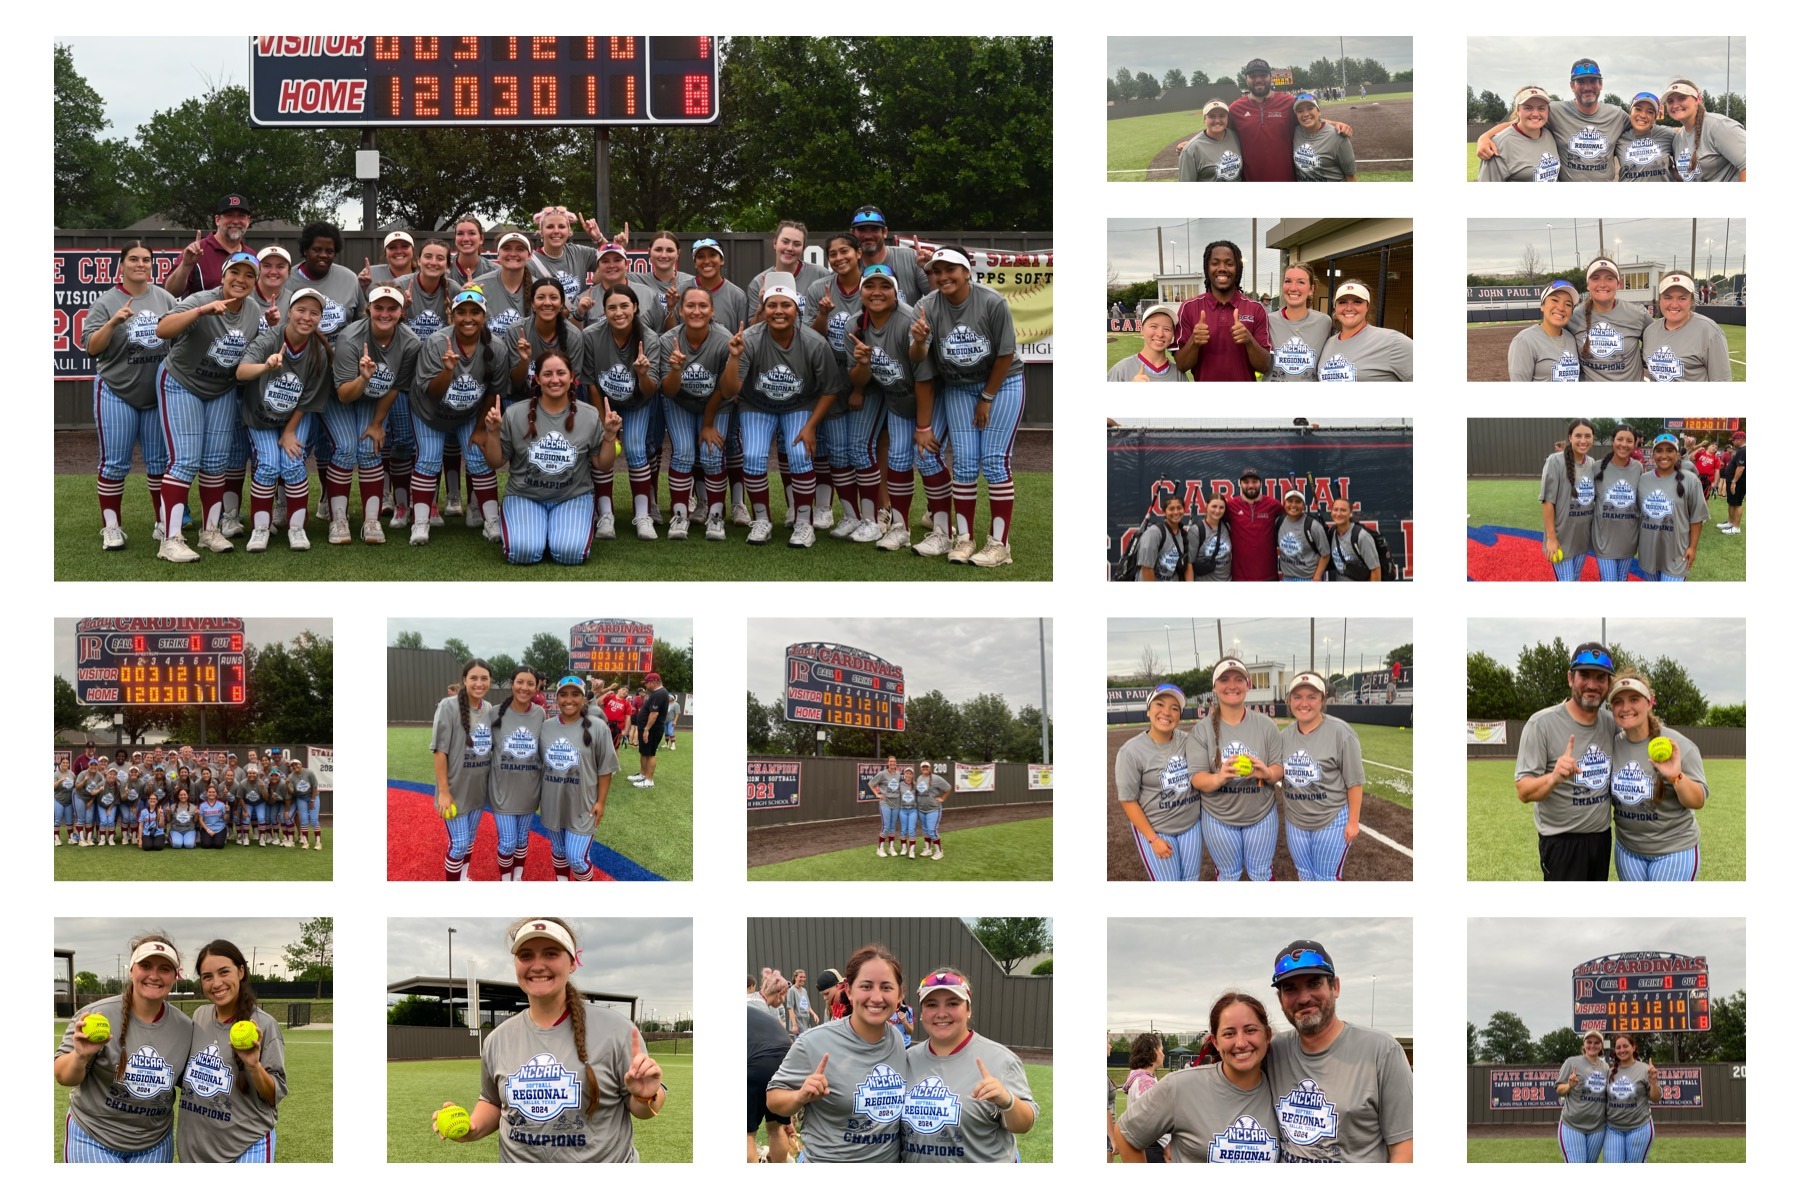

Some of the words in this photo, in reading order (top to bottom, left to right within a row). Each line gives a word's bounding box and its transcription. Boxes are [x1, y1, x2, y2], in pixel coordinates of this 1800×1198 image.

[279, 79, 367, 113] HOME
[392, 76, 400, 116] 1
[415, 76, 439, 115] 2
[455, 76, 478, 115] 0
[494, 76, 518, 115] 3
[533, 76, 556, 115] 0
[587, 76, 595, 115] 1
[628, 76, 635, 115] 1
[685, 75, 708, 115] 8
[1478, 288, 1504, 298] JOHN
[1507, 288, 1531, 298] PAUL
[762, 383, 797, 392] REGIONAL
[540, 439, 568, 450] NCCAA
[534, 452, 571, 462] REGIONAL
[115, 617, 242, 631] CARDINALS
[112, 638, 133, 649] BALL
[158, 638, 189, 649] STRIKE
[211, 637, 230, 648] OUT
[220, 656, 243, 665] RUNS
[820, 649, 902, 678] CARDINALS
[78, 668, 118, 680] VISITOR
[86, 688, 118, 701] HOME
[788, 687, 822, 702] VISITOR
[795, 706, 822, 719] HOME
[747, 763, 798, 775] CHAMPION
[1613, 783, 1646, 793] REGIONAL
[1604, 957, 1706, 974] CARDINALS
[1638, 978, 1663, 987] STRIKE
[1682, 977, 1697, 985] OUT
[1575, 1004, 1606, 1014] VISITOR
[1581, 1019, 1607, 1030] HOME
[132, 1055, 163, 1069] NCCAA
[196, 1053, 221, 1069] NCCAA
[125, 1072, 165, 1085] REGIONAL
[190, 1068, 223, 1086] REGIONAL
[519, 1065, 561, 1079] NCCAA
[869, 1075, 900, 1088] NCCAA
[512, 1089, 568, 1100] REGIONAL
[911, 1087, 946, 1098] NCCAA
[1291, 1092, 1324, 1106] NCCAA
[1512, 1086, 1545, 1100] 2021
[105, 1099, 168, 1117] CHAMPIONS
[905, 1106, 949, 1116] REGIONAL
[1282, 1112, 1326, 1128] REGIONAL
[509, 1128, 586, 1147] CHAMPIONS
[1228, 1129, 1266, 1142] NCCAA
[1294, 1130, 1308, 1139] 2024
[1219, 1150, 1271, 1160] REGIONAL
